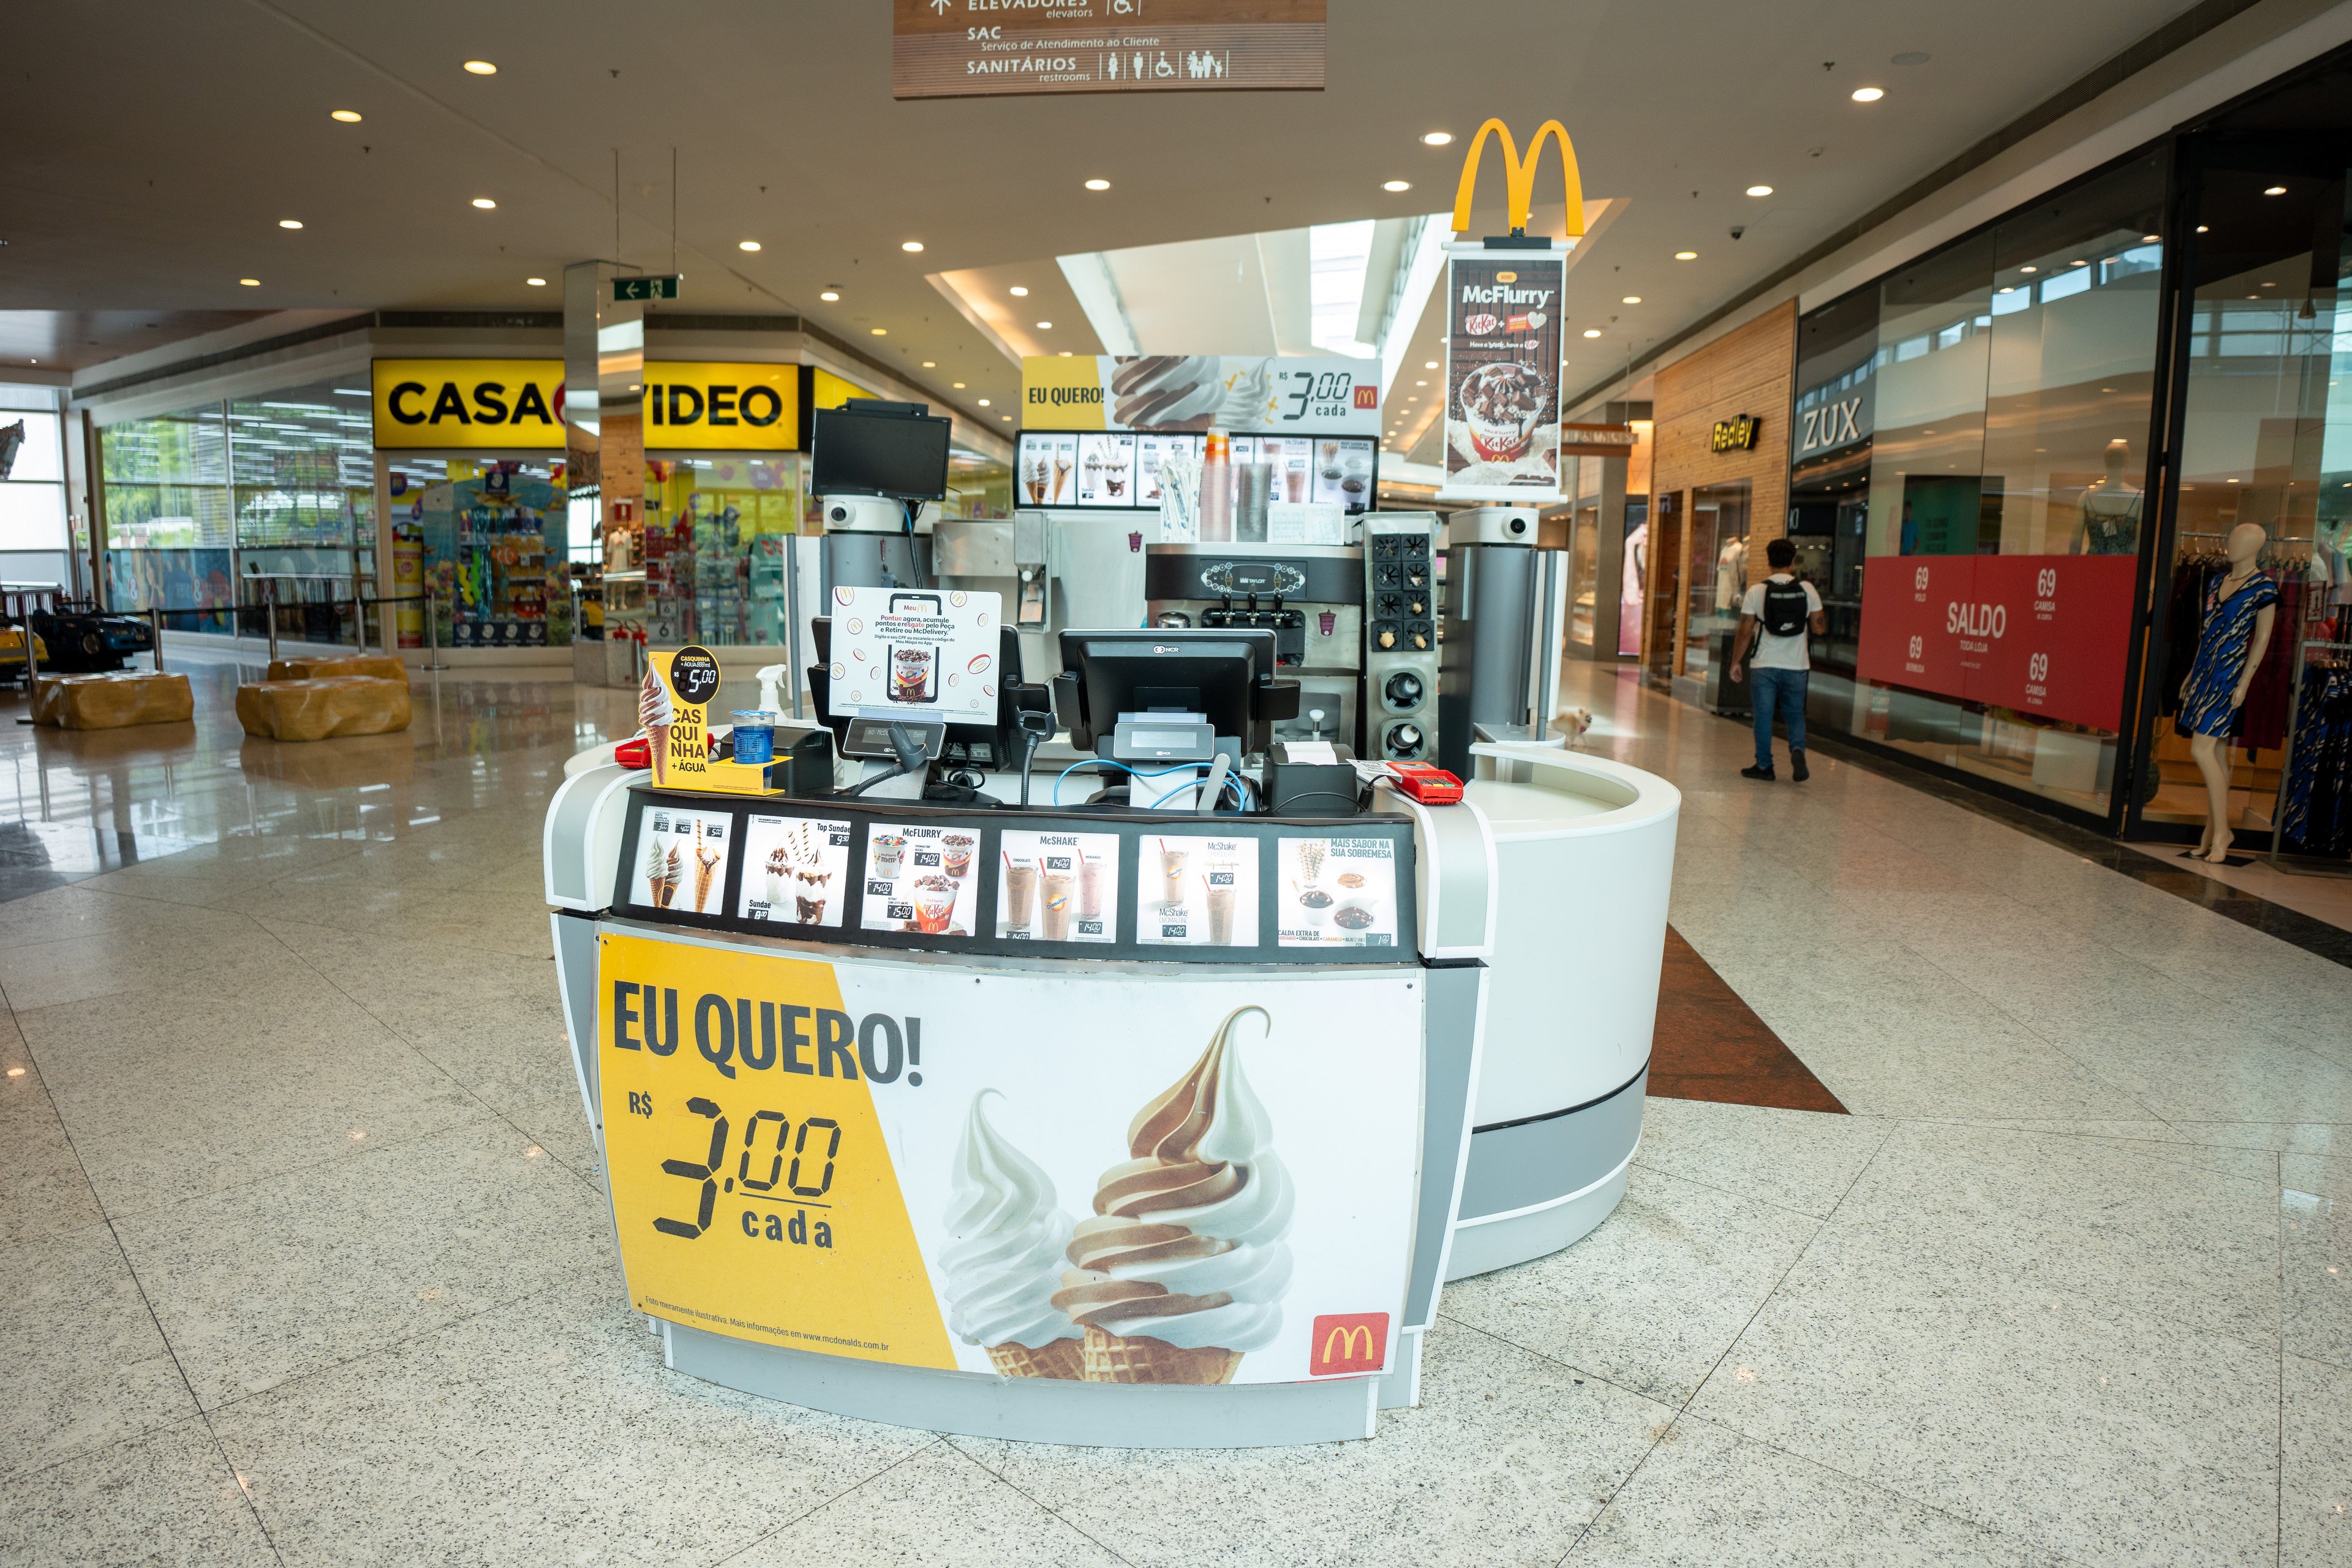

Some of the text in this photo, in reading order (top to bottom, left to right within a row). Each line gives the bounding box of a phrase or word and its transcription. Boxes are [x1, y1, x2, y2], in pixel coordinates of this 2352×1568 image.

[1046, 9, 1093, 18] elevators
[967, 26, 1002, 40] SAC
[981, 42, 1018, 51] Serviço
[1020, 40, 1033, 50] de
[1036, 39, 1104, 49] Atendimento
[1123, 37, 1160, 47] Cliente
[967, 56, 1077, 74] SANITÁRIOS
[1462, 285, 1549, 309] McFlurry
[1469, 315, 1495, 334] KitKat
[1279, 371, 1288, 380] R$
[388, 381, 783, 428] CASA IDEO
[1029, 387, 1105, 407] EU QUERO!
[1316, 404, 1346, 416] cada
[1803, 397, 1861, 451] ZUX
[1713, 415, 1754, 451] Redley
[1485, 437, 1517, 451] KitKat
[1915, 566, 1929, 590] 69
[2037, 568, 2056, 598] 69
[2034, 600, 2056, 612] CAMISA
[1947, 601, 2007, 639] SALDO
[1909, 635, 1923, 660] 69
[1960, 639, 1988, 654] TODA LOJA
[2029, 652, 2048, 682] 69
[2026, 684, 2047, 697] CAMISA
[673, 708, 701, 724] CAS
[670, 725, 698, 743] QUI
[671, 743, 706, 759] NHA
[679, 759, 706, 773] ÁGUA
[817, 823, 851, 833] Top Sundae
[902, 828, 941, 838] McFLURRY
[1040, 836, 1077, 846] McSHAKE
[1207, 842, 1236, 851] McShake
[1331, 839, 1390, 849] MAIS SABOR NA
[1330, 848, 1392, 858] SUA SOBREMESA
[749, 899, 771, 908] Sundae
[924, 904, 944, 918] KitKat
[1046, 897, 1068, 910] Ovomaltine
[1159, 908, 1188, 917] McShake
[614, 980, 923, 1087] EU QUERO!
[628, 1091, 653, 1119] R$
[742, 1210, 832, 1249] cada
[645, 1295, 889, 1351] Foto meramente ilustrativa. Mais informações em www.mcdonalds.com.br
